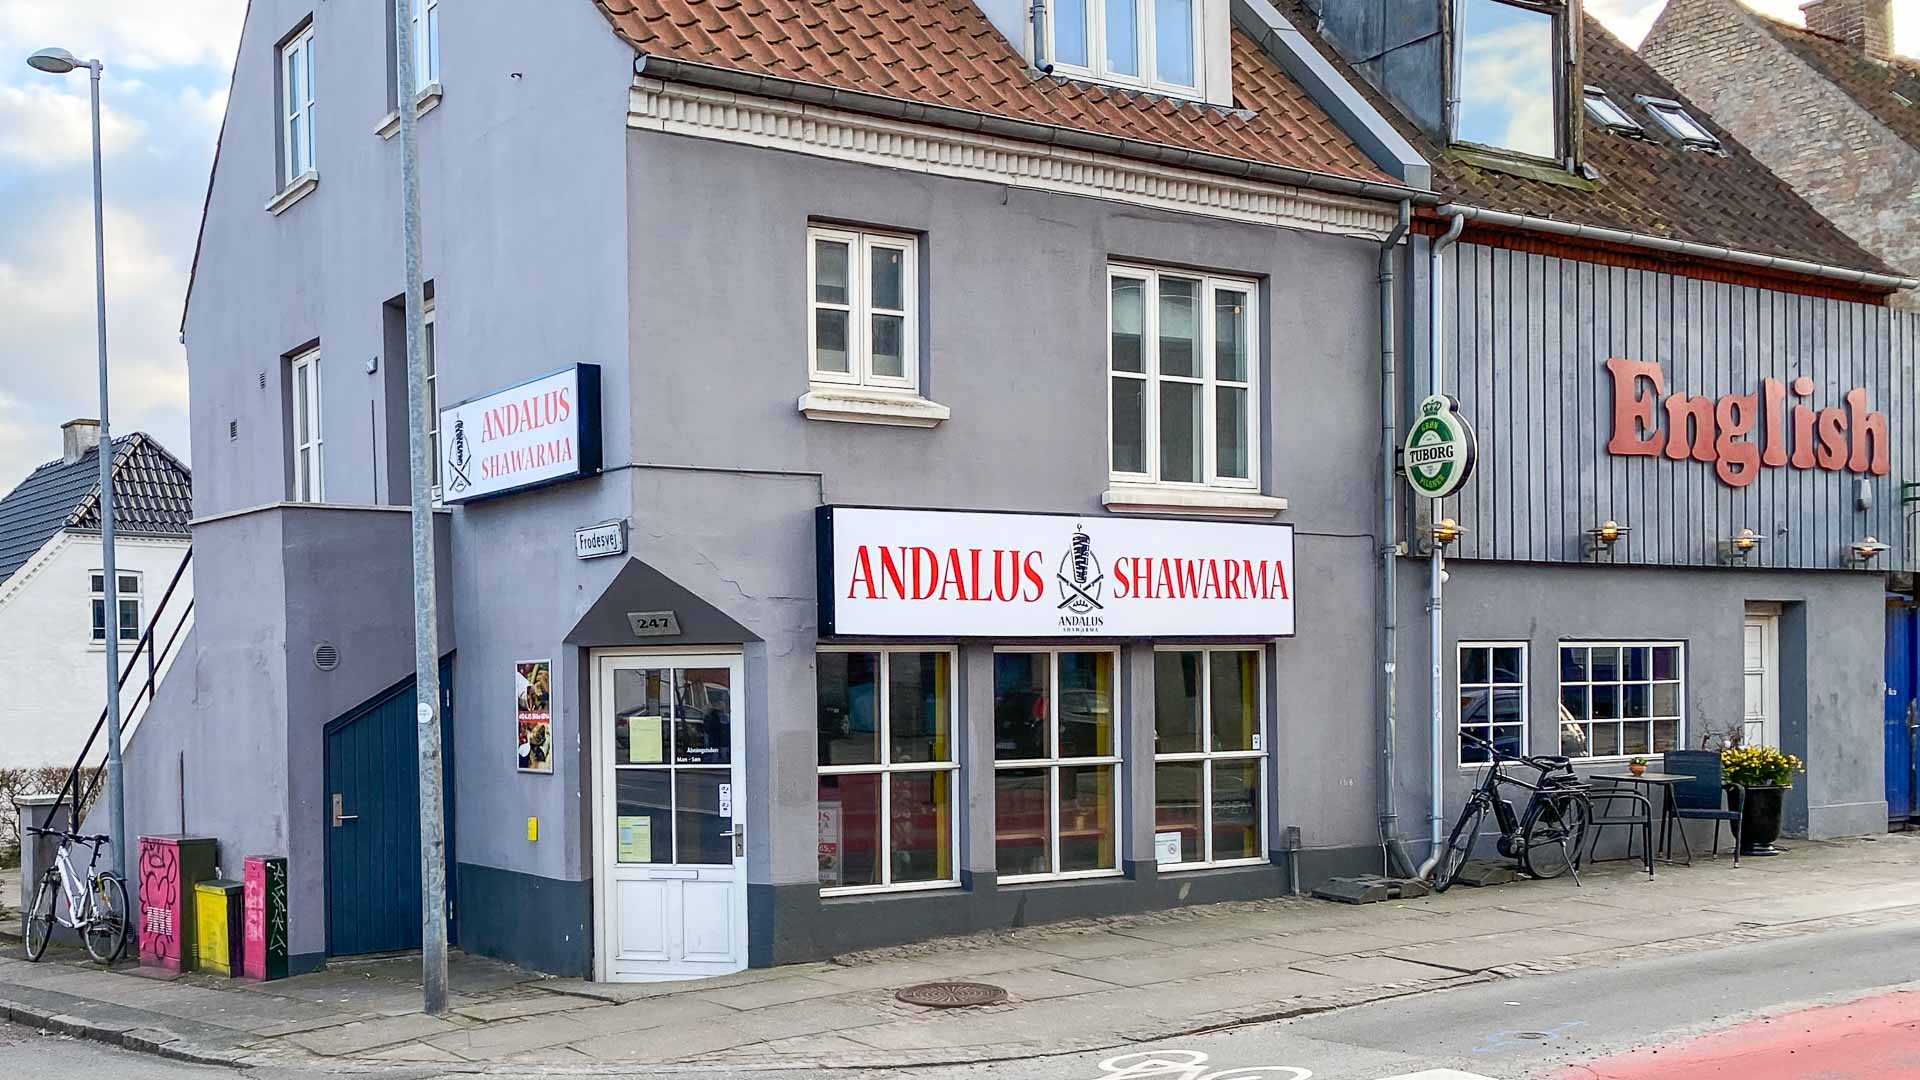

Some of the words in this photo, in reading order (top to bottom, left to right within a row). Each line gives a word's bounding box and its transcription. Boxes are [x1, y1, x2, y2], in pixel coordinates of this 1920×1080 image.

[481, 386, 570, 443] ANDALUS
[1606, 357, 1891, 487] English
[481, 437, 573, 480] SHAWARMA
[1410, 445, 1454, 463] TUBORG
[579, 530, 618, 550] Frodesvej
[846, 544, 1045, 603] ANDALUS
[1113, 556, 1290, 600] SHAWARMA
[636, 617, 669, 629] 247
[1058, 616, 1104, 626] ANDALUS
